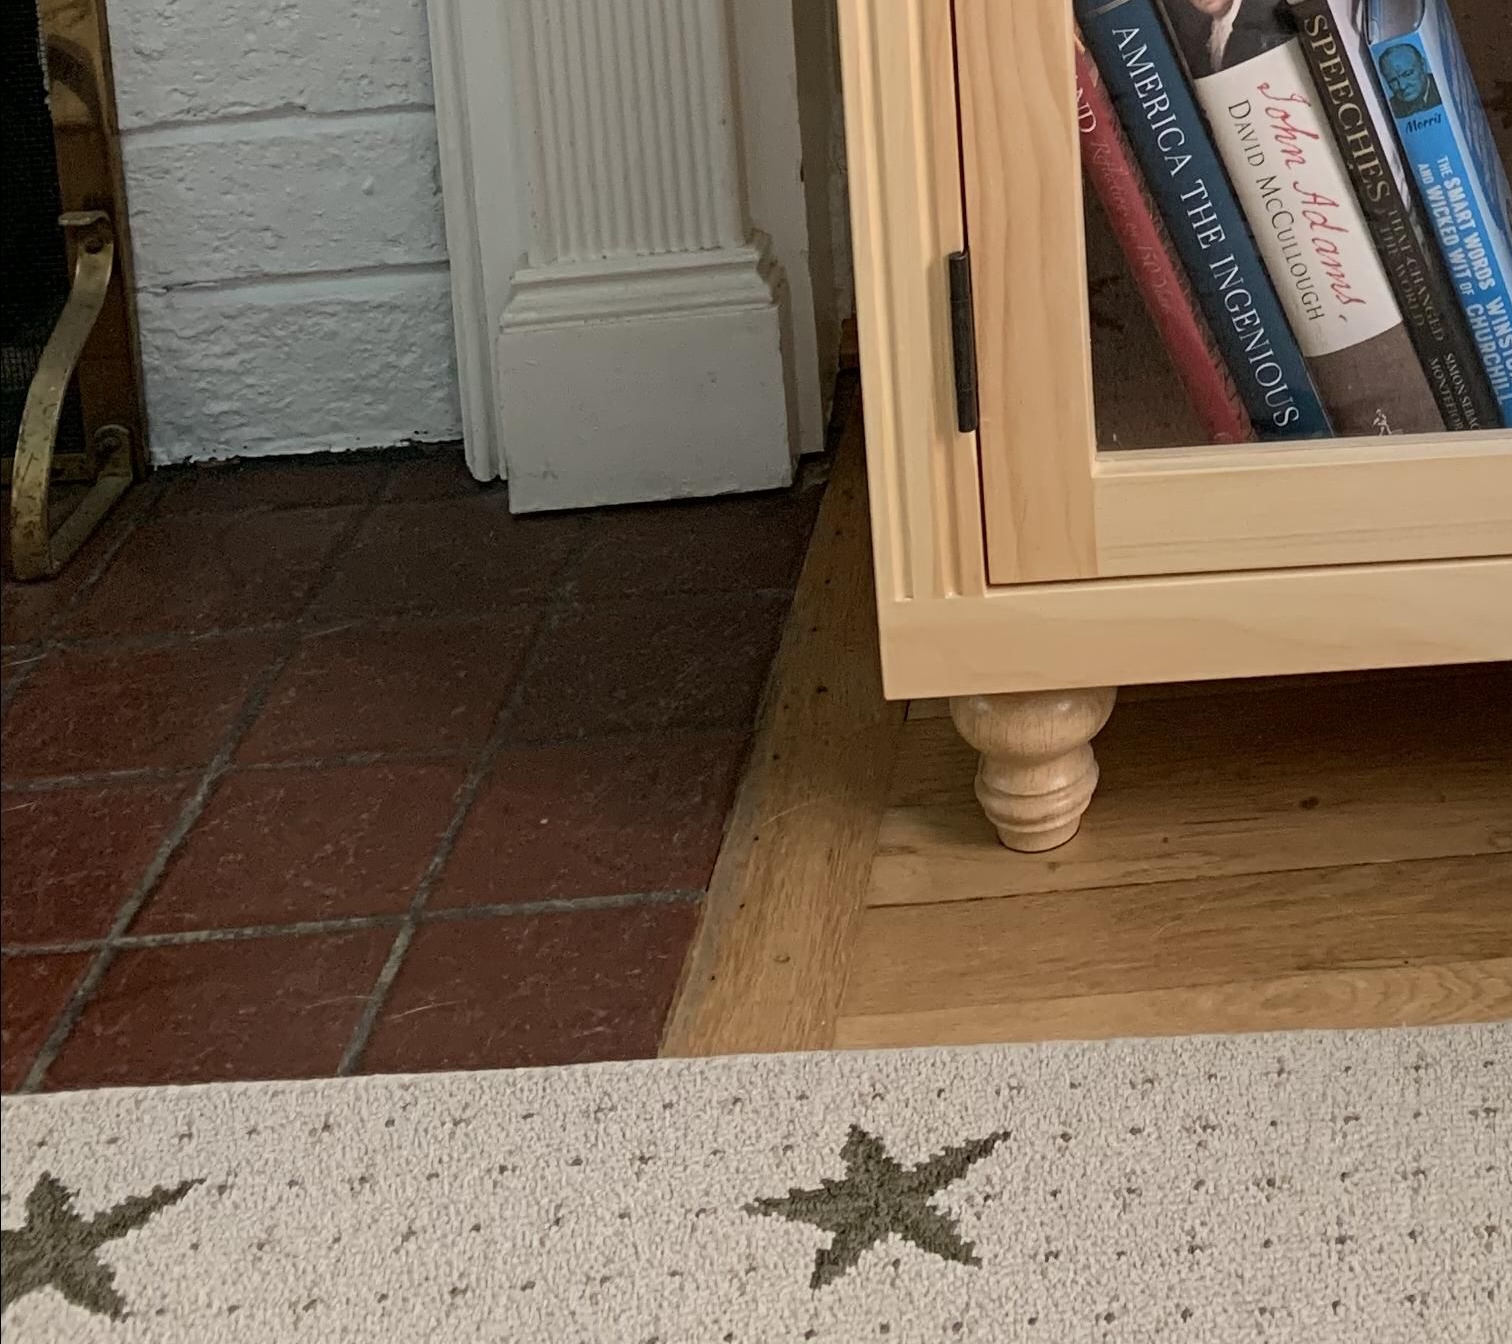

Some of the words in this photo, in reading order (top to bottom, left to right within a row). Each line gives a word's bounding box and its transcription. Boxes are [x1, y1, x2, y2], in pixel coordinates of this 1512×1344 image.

[1227, 98, 1266, 168] DAVID
[1303, 13, 1392, 204] SPEECHES
[1405, 112, 1443, 134] Morris
[1256, 80, 1320, 170] John
[1292, 179, 1368, 307] Adams
[1417, 162, 1435, 186] AND
[1436, 153, 1454, 179] THE
[1110, 26, 1193, 178] AMERICA
[1179, 178, 1227, 250] THE
[1208, 253, 1301, 428] INGENIOUS
[1425, 183, 1461, 247] WICKED
[1442, 176, 1477, 232] SMART
[1447, 245, 1474, 281] WIT
[1458, 280, 1476, 297] OF
[1463, 230, 1497, 292] WORDS
[1443, 351, 1470, 398] SIMON
